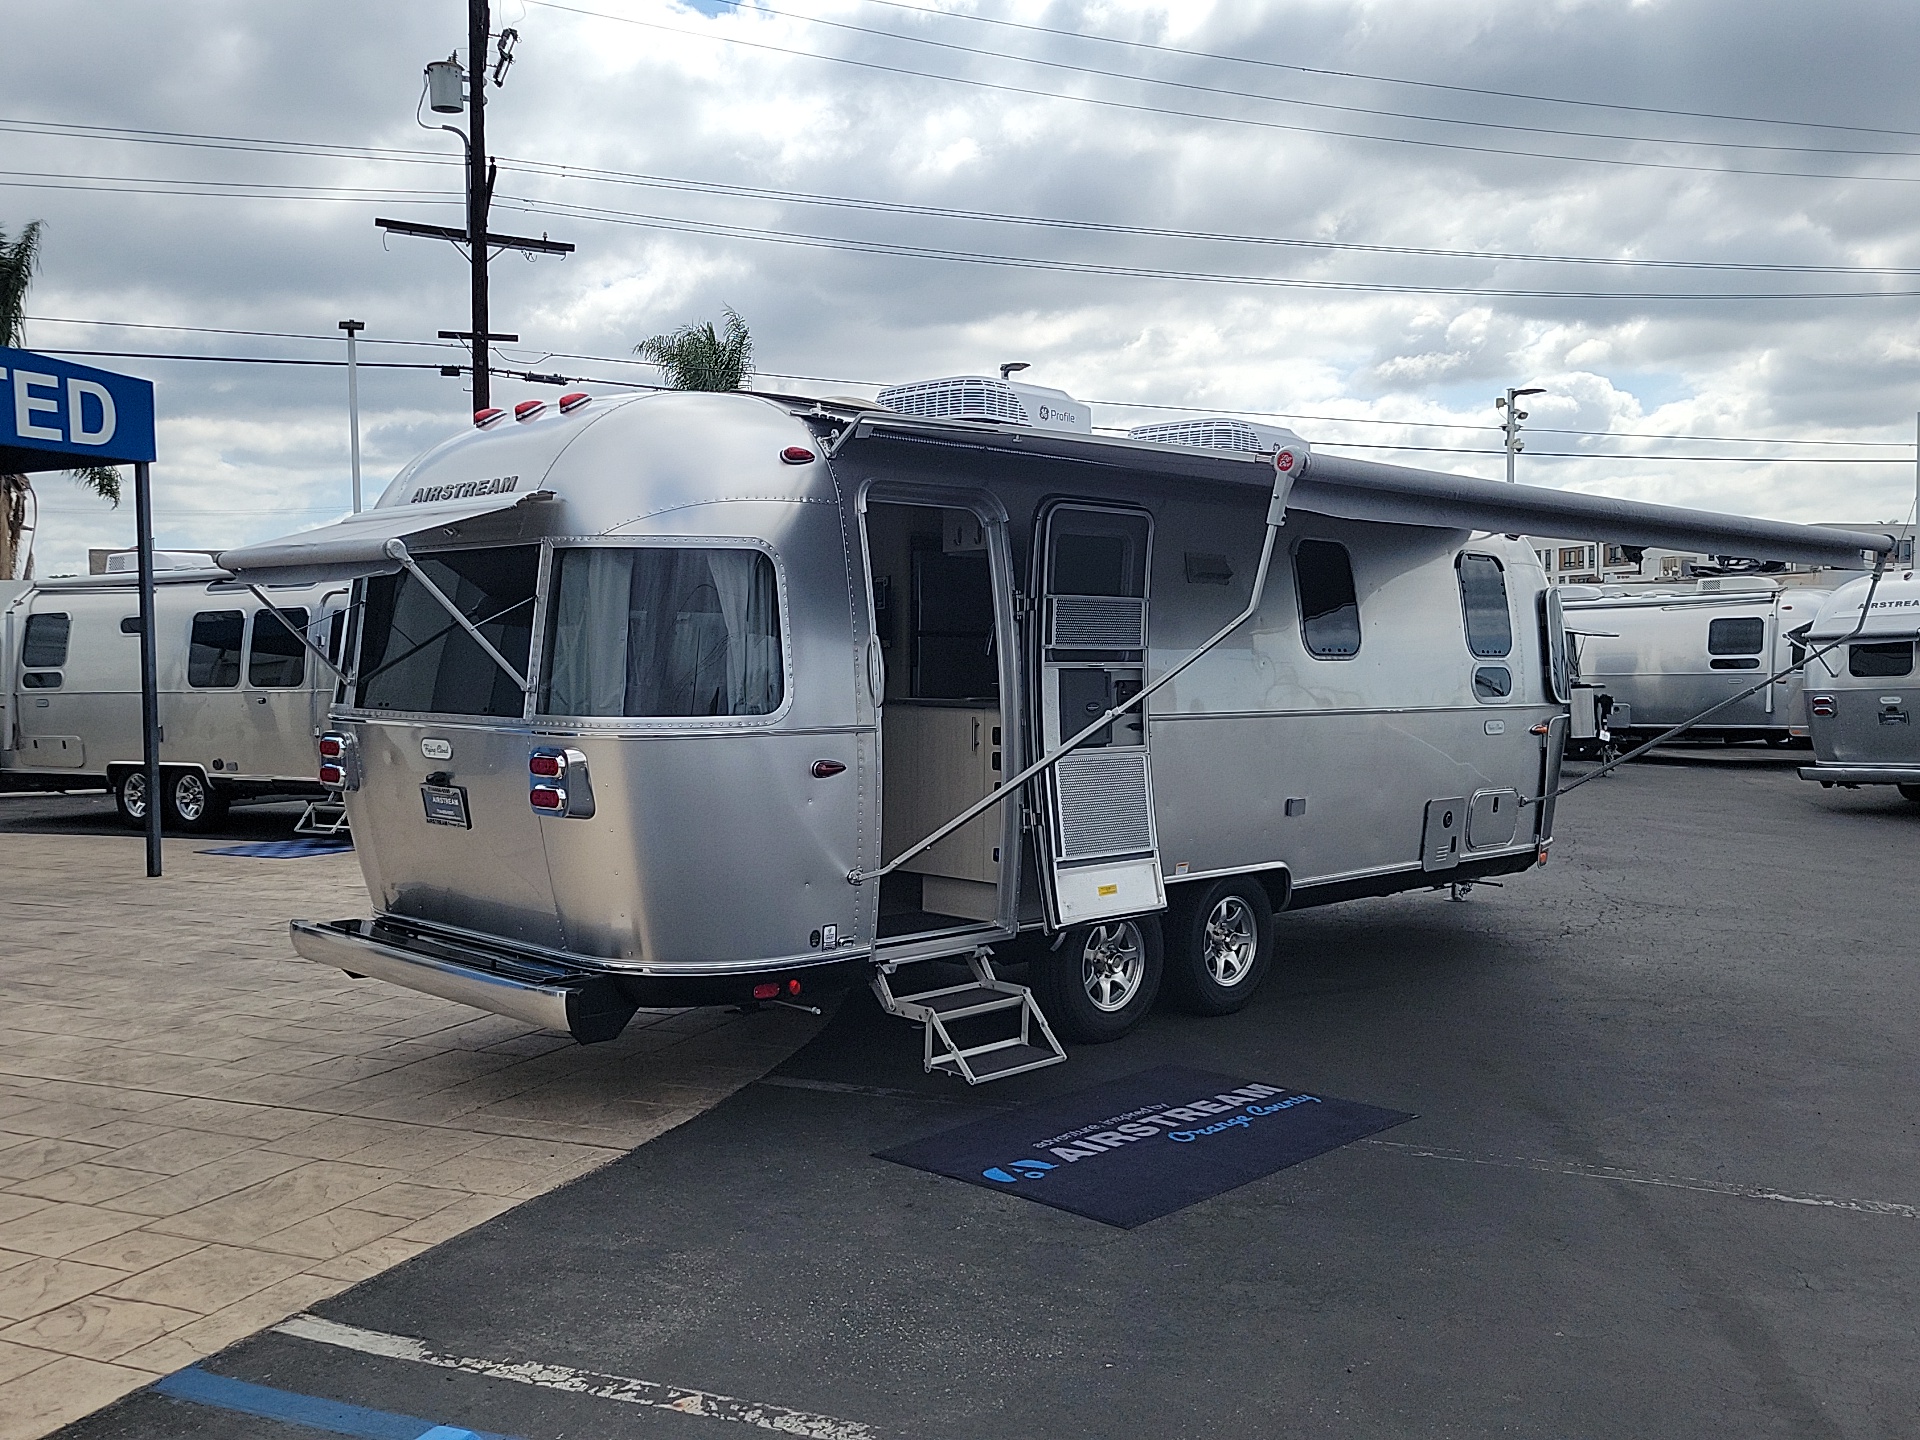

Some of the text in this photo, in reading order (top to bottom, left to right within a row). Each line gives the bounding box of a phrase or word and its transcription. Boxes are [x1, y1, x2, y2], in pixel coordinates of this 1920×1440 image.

[0, 367, 117, 445] ED
[1051, 409, 1075, 423] Profile
[411, 476, 519, 503] AIRSTREAM
[1050, 1083, 1286, 1163] AIRSTREAM
[1168, 1094, 1322, 1142] Orange County
